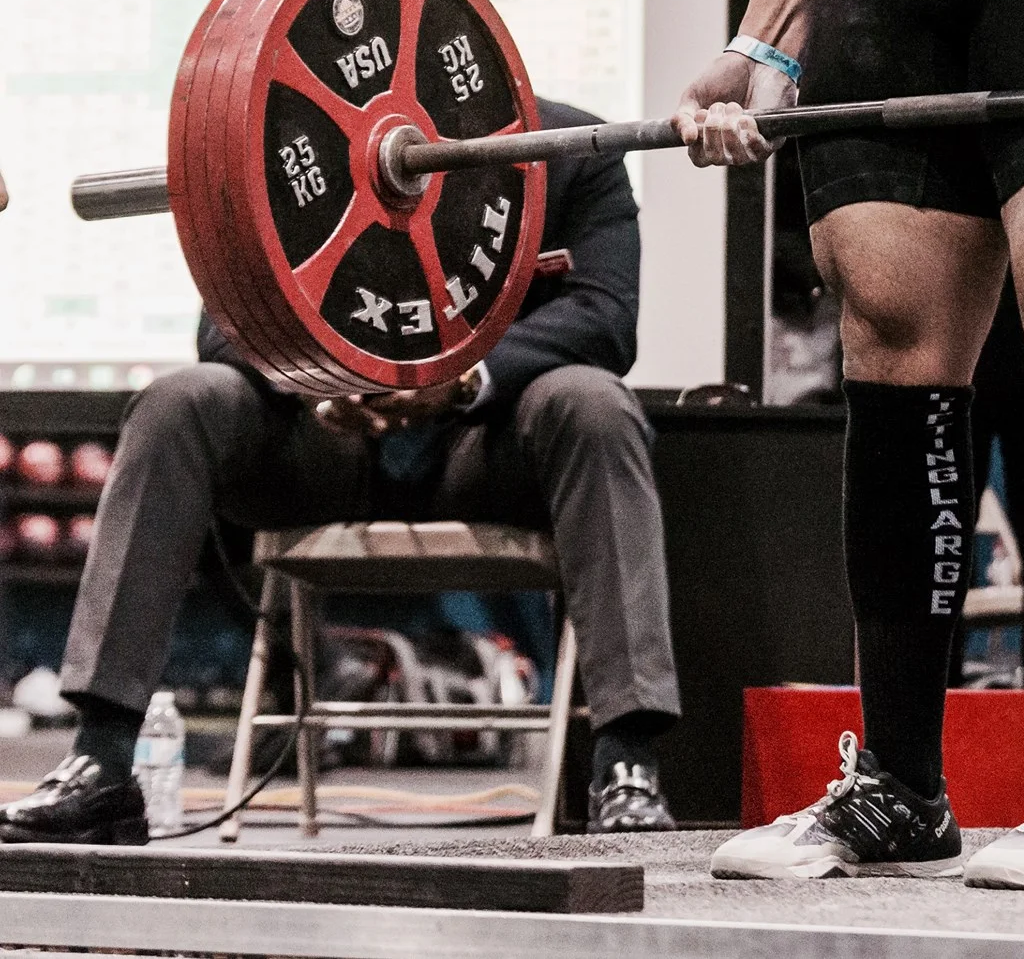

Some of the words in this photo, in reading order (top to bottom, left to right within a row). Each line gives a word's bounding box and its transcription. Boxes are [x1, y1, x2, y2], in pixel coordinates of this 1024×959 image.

[336, 36, 393, 89] USA
[438, 35, 474, 73] KG
[451, 63, 484, 102] 25
[278, 135, 315, 178] 25
[289, 166, 326, 208] KG
[351, 196, 512, 334] TITEX
